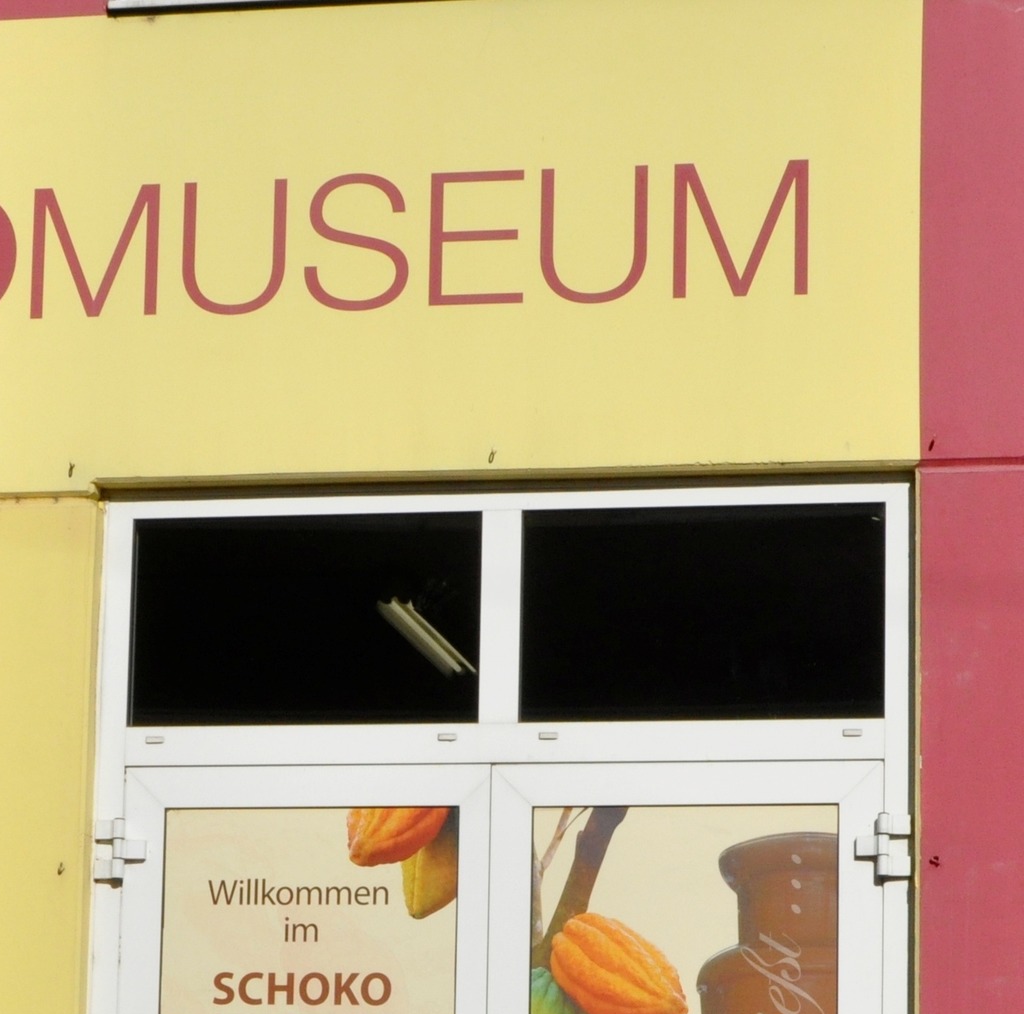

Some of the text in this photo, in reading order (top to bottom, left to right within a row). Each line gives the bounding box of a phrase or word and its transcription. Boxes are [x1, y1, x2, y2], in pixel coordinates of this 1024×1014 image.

[208, 878, 390, 906] Willkommen
[284, 916, 319, 943] im
[212, 971, 392, 1006] SCHOKO
